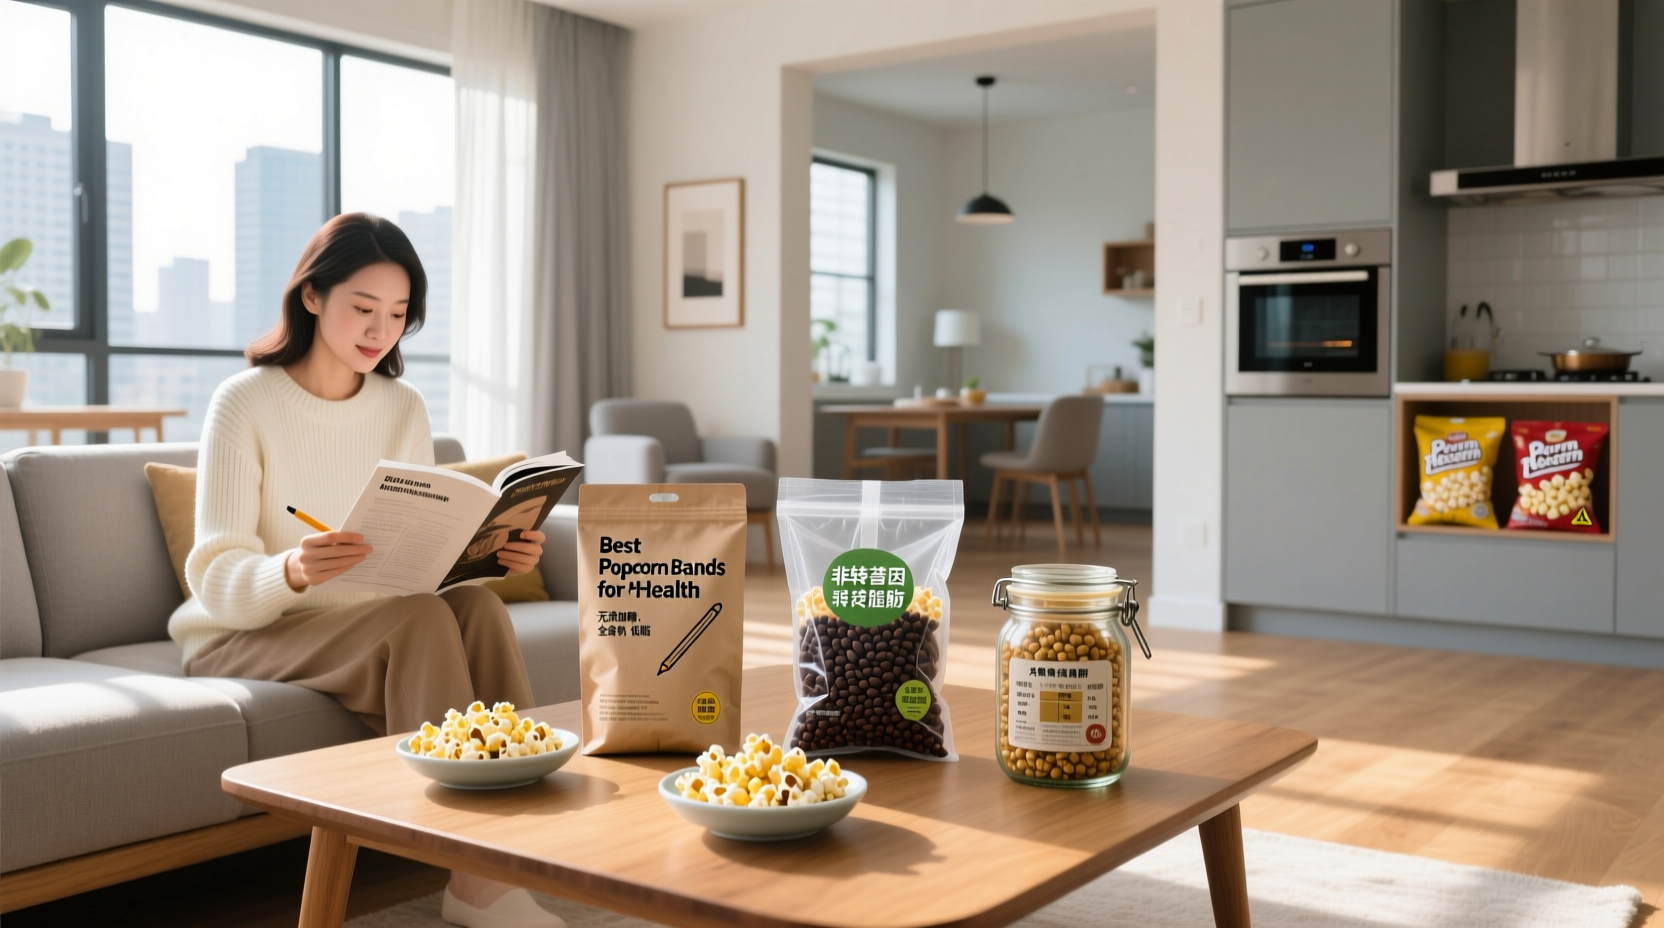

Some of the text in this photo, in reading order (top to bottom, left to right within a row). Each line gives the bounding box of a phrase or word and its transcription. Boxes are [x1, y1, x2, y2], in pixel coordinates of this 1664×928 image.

[600, 536, 642, 554] Best
[599, 558, 726, 581] Popcorn Bands
[597, 580, 626, 598] for
